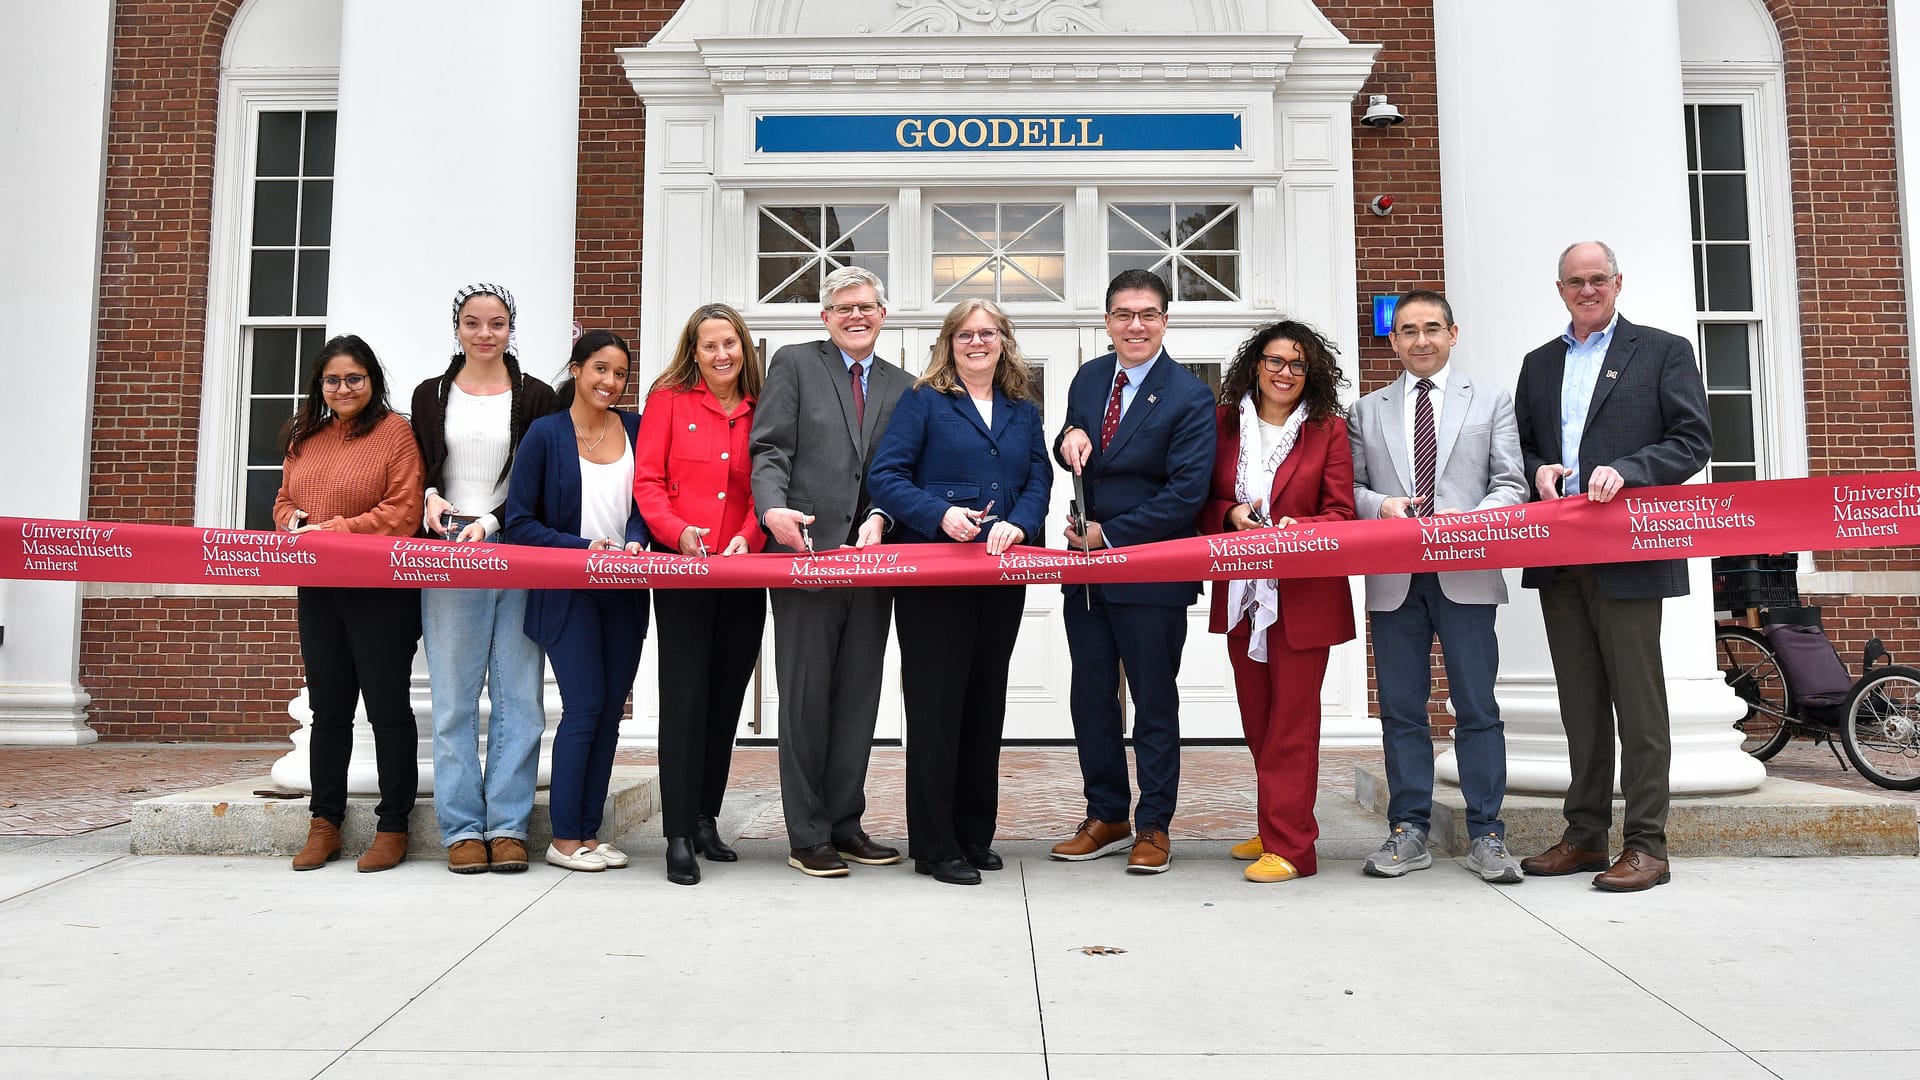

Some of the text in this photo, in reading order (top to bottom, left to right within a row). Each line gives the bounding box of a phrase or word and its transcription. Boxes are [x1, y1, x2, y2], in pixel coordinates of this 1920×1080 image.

[896, 118, 1103, 147] GOODELL
[1625, 494, 1735, 515] University of
[1417, 507, 1527, 527] University of
[1629, 511, 1756, 533] Massachusetts
[21, 522, 115, 541] University of
[1303, 527, 1316, 536] of
[1420, 522, 1551, 545] Massachusetts
[1835, 521, 1899, 538] Amherst
[202, 529, 299, 549] University of
[1208, 535, 1340, 558] Massachusetts
[1631, 534, 1694, 550] Amherst
[22, 539, 132, 558] Massachusetts
[202, 545, 317, 565] Massachusetts
[392, 540, 495, 555] University of
[1421, 545, 1487, 561] Amherst
[23, 556, 78, 572] Amherst
[389, 551, 509, 571] Massachusetts
[886, 552, 899, 564] of
[1209, 557, 1275, 573] Amherst
[204, 563, 261, 577] Amherst
[584, 558, 710, 576] Massachusetts
[789, 561, 918, 577] Massachusetts
[392, 569, 451, 582] Amherst
[588, 574, 649, 584] Amherst
[791, 577, 854, 585] Amherst
[999, 570, 1063, 581] Amherst
